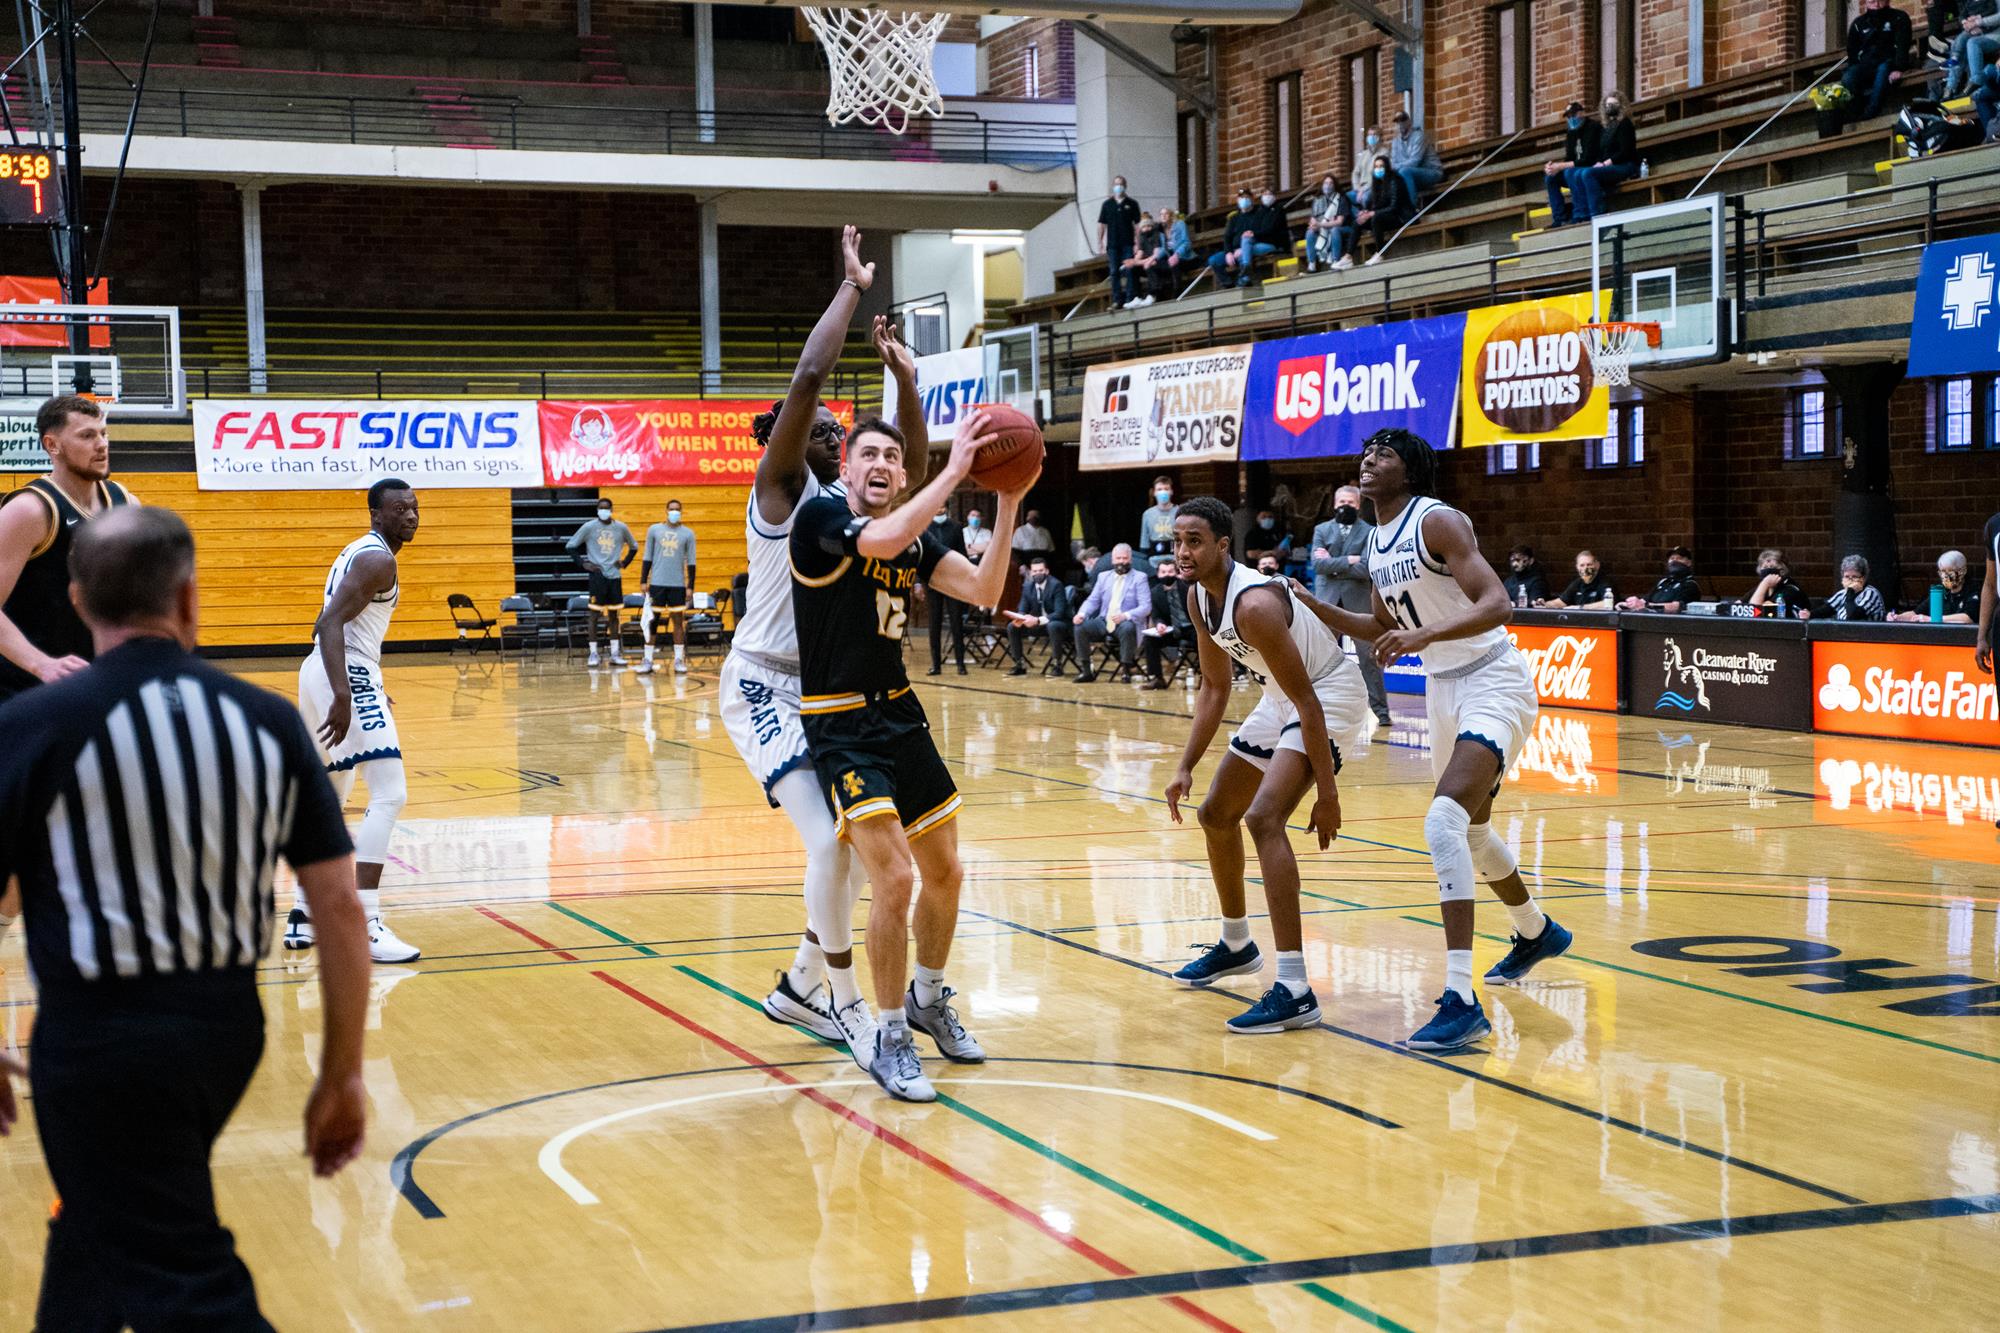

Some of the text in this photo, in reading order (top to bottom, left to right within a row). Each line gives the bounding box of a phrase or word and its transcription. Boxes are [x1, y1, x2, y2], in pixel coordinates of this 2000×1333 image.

[20, 179, 42, 214] 7
[1148, 355, 1247, 381] PROUDLY SUPPORTS
[1485, 331, 1580, 380] IDAHO
[1157, 377, 1238, 418] VANDAL
[1484, 374, 1580, 411] POTATOES
[212, 411, 519, 450] FASTSIGNS
[636, 412, 694, 428] YOUR
[1089, 416, 1143, 433] Farm Bureau
[657, 435, 762, 452] WHEN THE
[1089, 431, 1142, 450] INSURANCE
[212, 455, 524, 477] More than fast. More than signs.
[550, 443, 641, 481] Wendy's
[1392, 558, 1421, 585] STATE
[876, 588, 908, 641] 12
[1731, 604, 1755, 618] POSS
[1692, 648, 1778, 674] Clearwater River
[1702, 669, 1769, 686] CASINO & LODGE
[347, 664, 387, 732] BOBCATS
